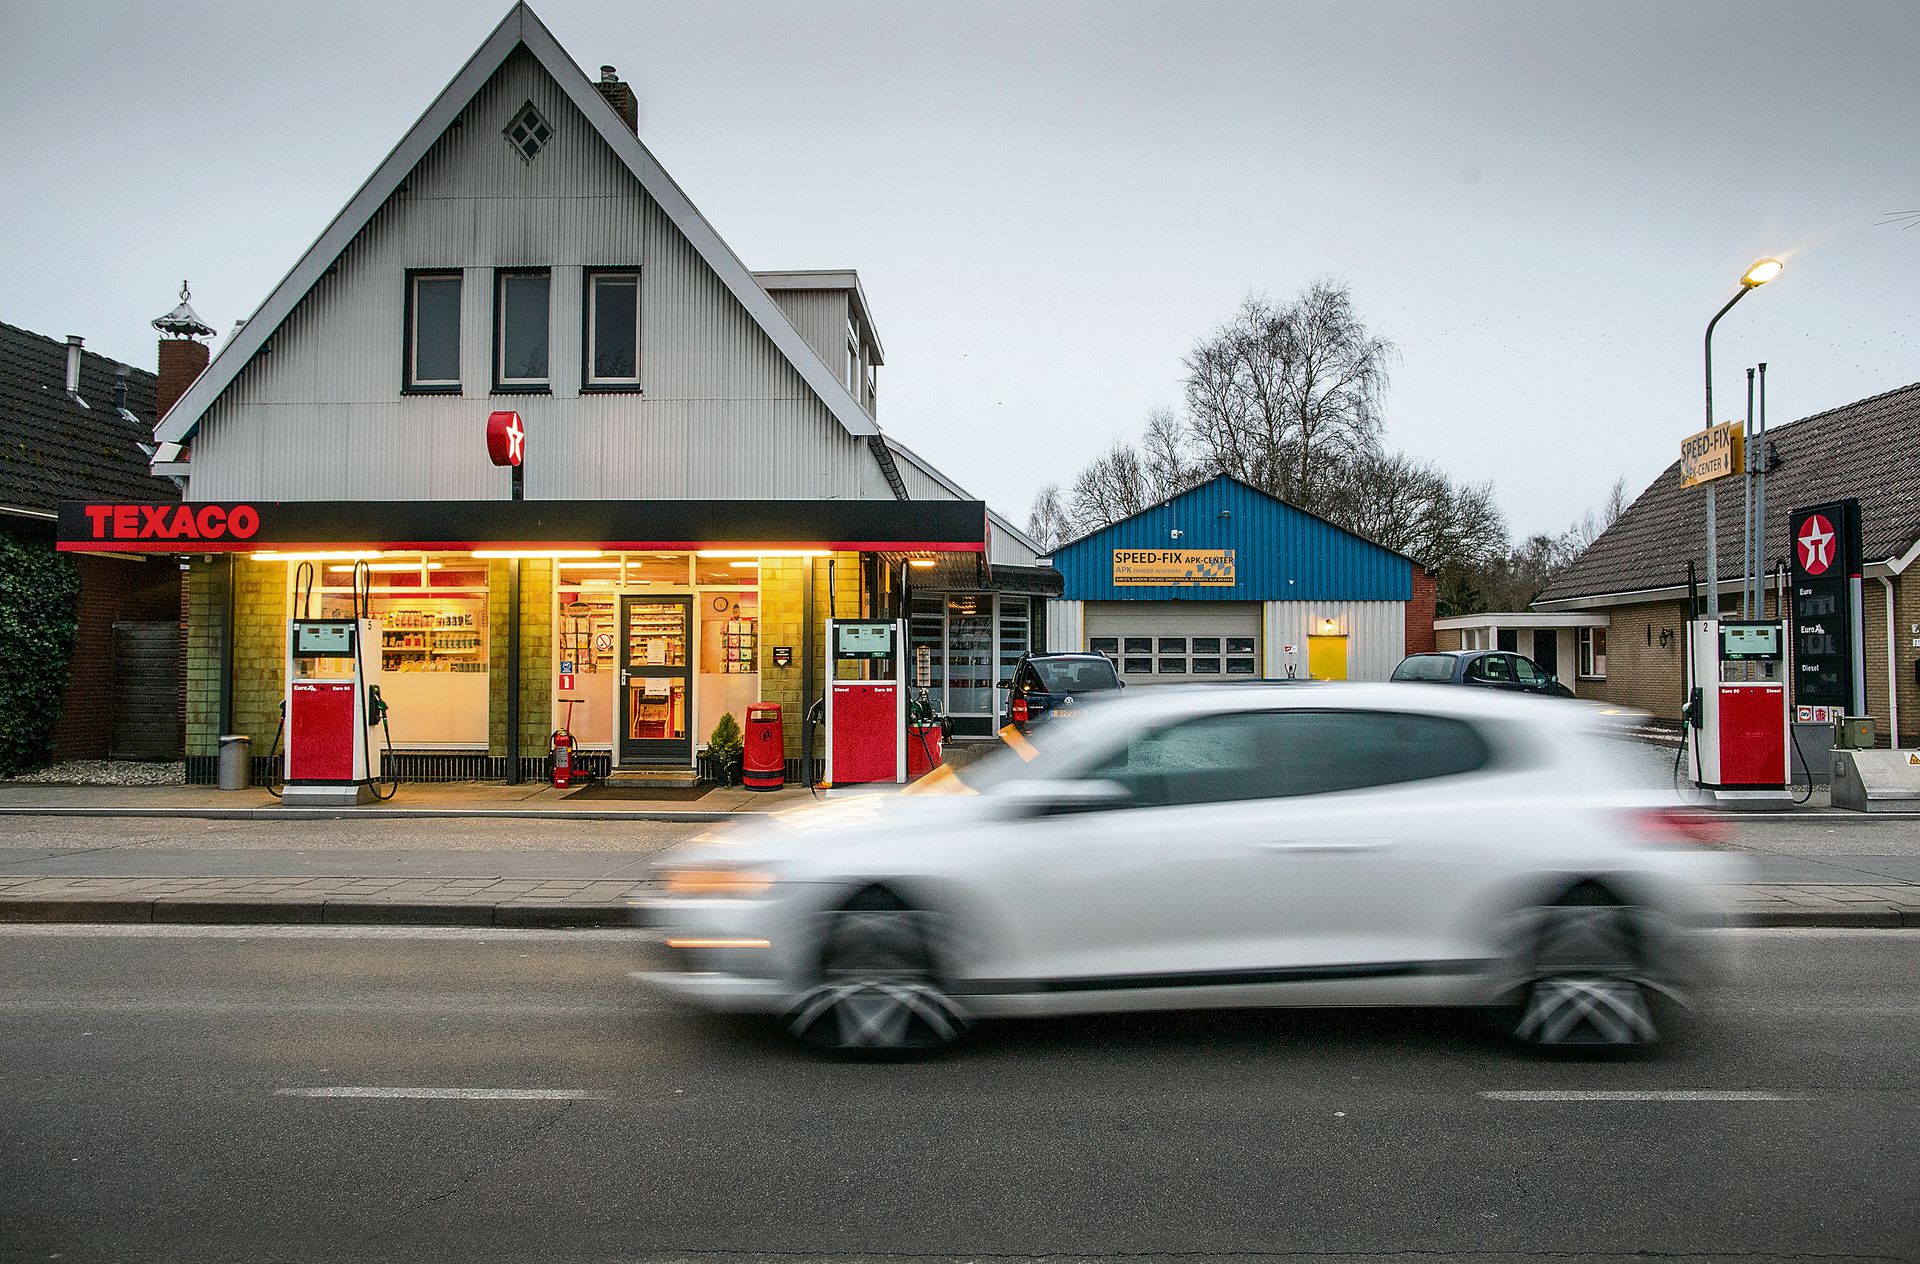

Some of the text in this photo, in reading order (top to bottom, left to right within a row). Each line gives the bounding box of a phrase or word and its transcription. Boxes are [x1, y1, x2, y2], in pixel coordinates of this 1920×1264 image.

[1681, 426, 1730, 463] SPEED-FIX
[85, 505, 260, 539] TEXACO
[1115, 552, 1234, 564] SPEED-FIX APK-CENTER
[368, 620, 372, 630] 5
[1703, 622, 1708, 632] 2
[1802, 664, 1820, 672] Diesel
